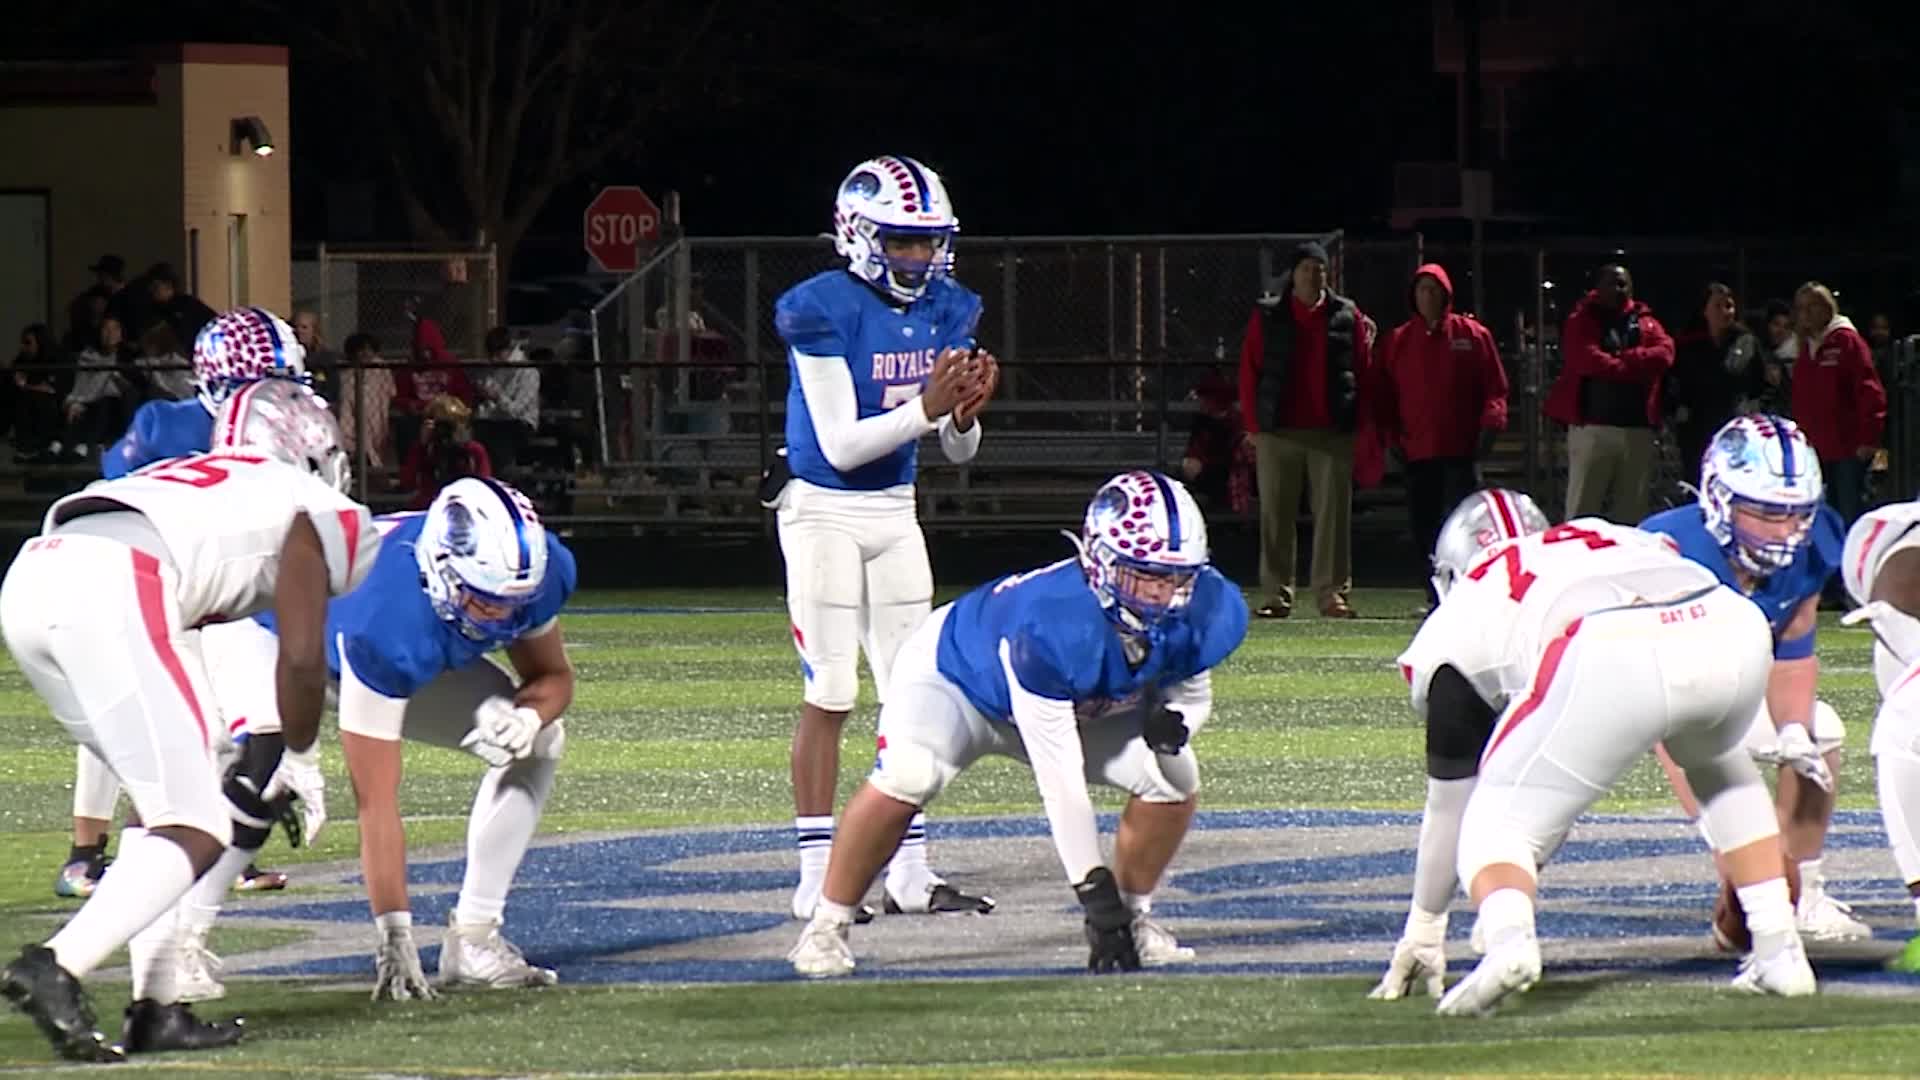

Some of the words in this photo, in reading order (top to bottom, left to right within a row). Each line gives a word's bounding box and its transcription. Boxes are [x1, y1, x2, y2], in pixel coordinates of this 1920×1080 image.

[591, 214, 655, 245] STOP
[872, 349, 936, 380] ROYALS
[1467, 523, 1618, 603] 74
